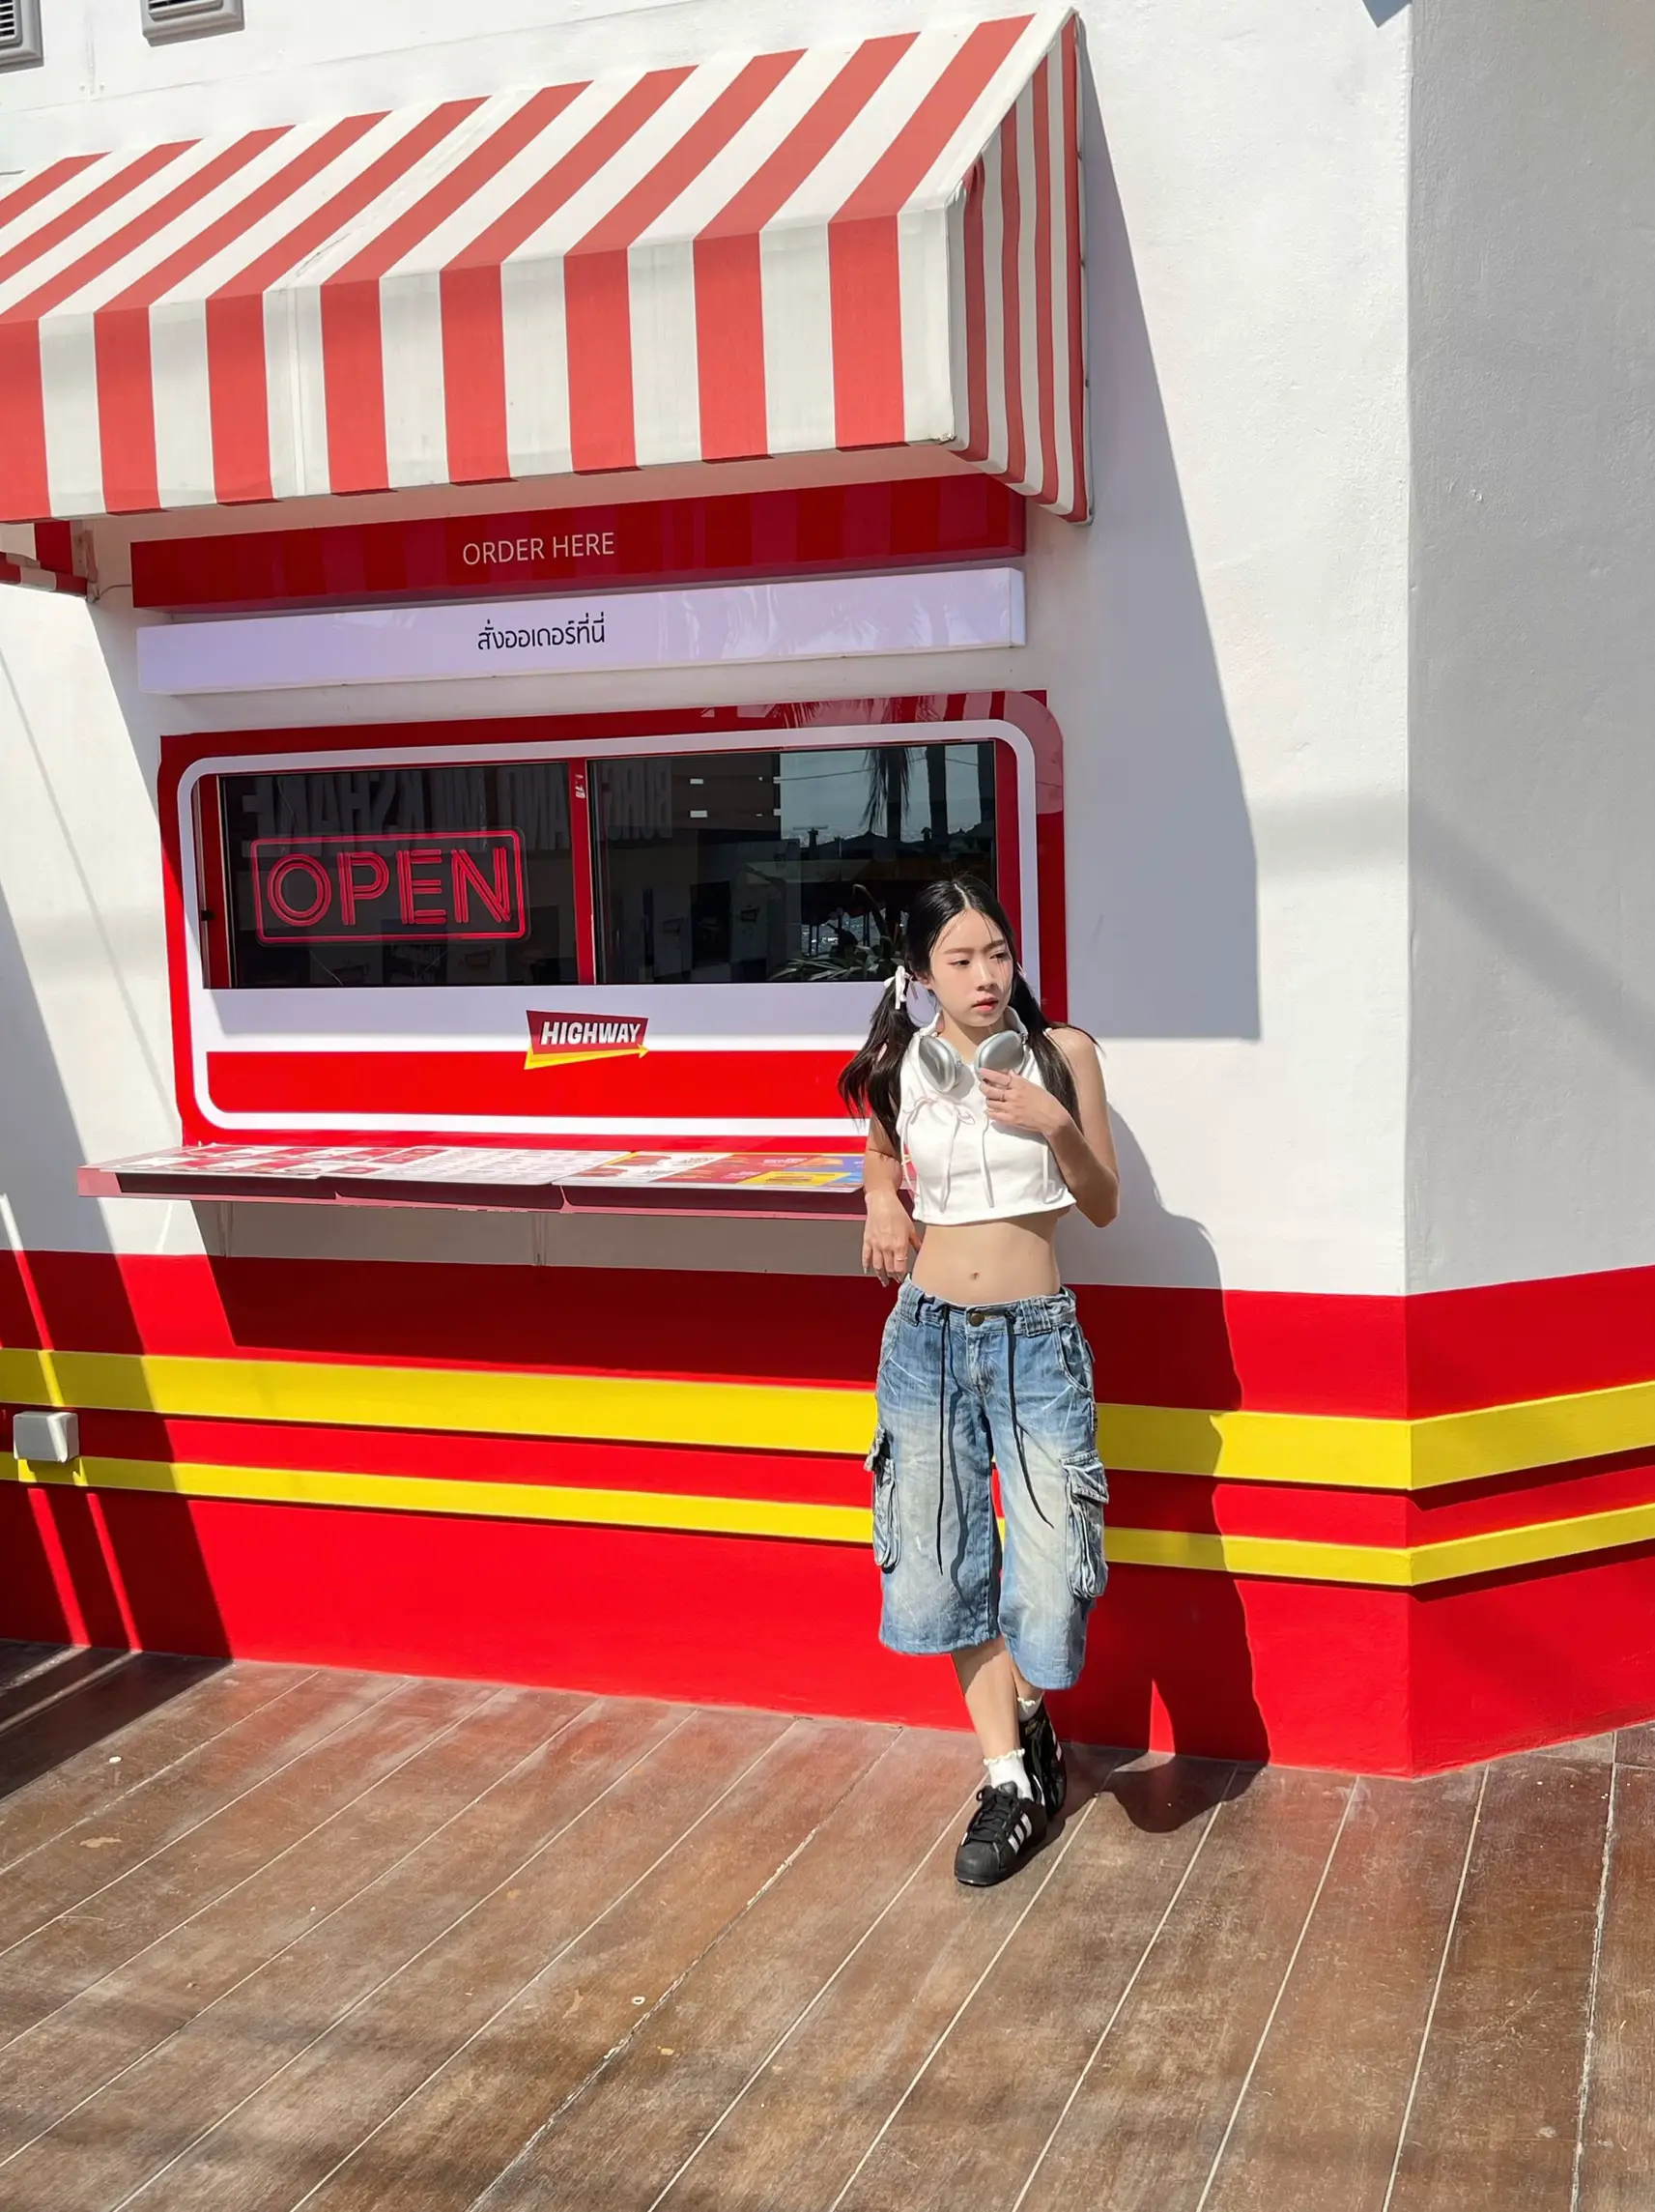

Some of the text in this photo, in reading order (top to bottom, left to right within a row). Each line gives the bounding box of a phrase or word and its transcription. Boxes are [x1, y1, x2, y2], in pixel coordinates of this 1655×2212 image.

[463, 532, 615, 565] ORDER HERE
[477, 612, 606, 650] สั่งออเดอร์ที่นี่
[267, 847, 511, 927] OPEN
[540, 1020, 642, 1046] HIGHWAY
